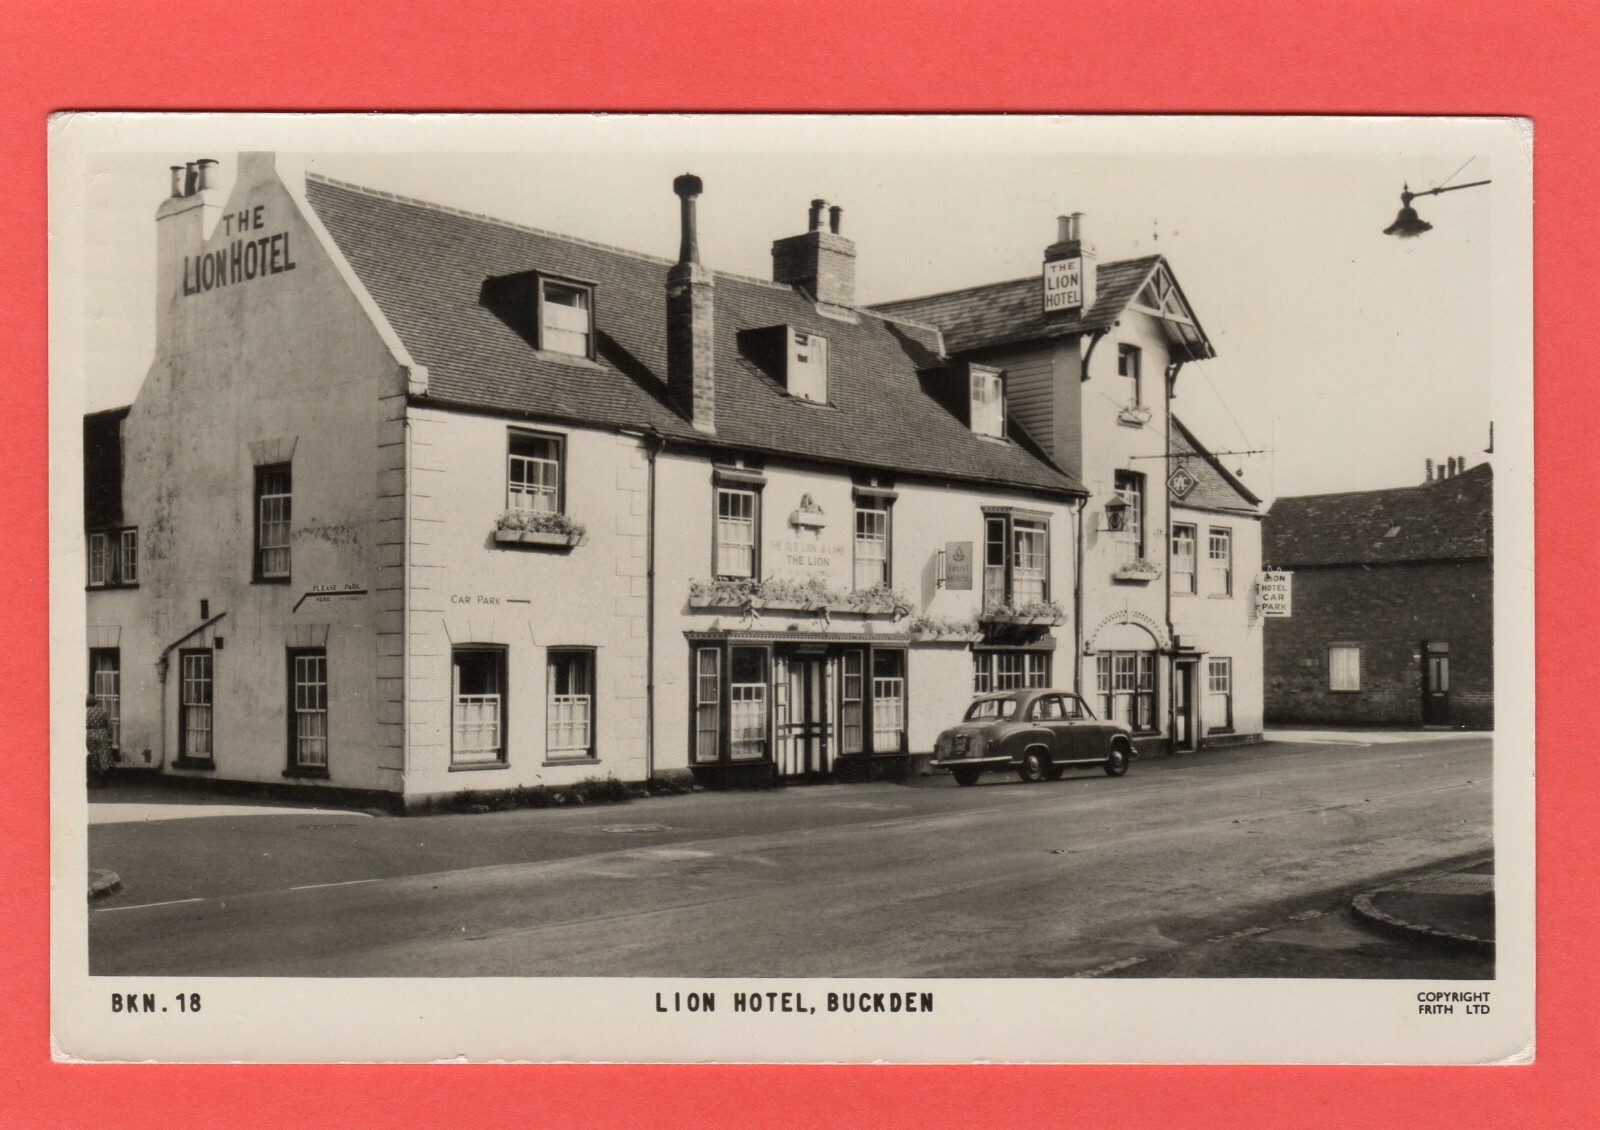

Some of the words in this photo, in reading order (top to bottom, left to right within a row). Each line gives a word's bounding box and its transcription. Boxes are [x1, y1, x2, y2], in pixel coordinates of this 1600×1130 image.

[223, 205, 264, 236] THE
[183, 248, 227, 297] LION
[230, 231, 296, 285] HOTEL
[1050, 261, 1075, 272] THE
[1047, 273, 1078, 291] LION
[1045, 290, 1081, 307] HOTEL
[786, 555, 804, 566] THE
[807, 556, 830, 567] LION
[313, 584, 337, 592] PLEASE
[344, 583, 361, 591] PARK
[1261, 584, 1287, 592] HOTEL
[451, 594, 471, 604] CAR
[477, 595, 501, 605] PARK
[1262, 593, 1285, 601] CAR
[1261, 603, 1287, 611] PARK
